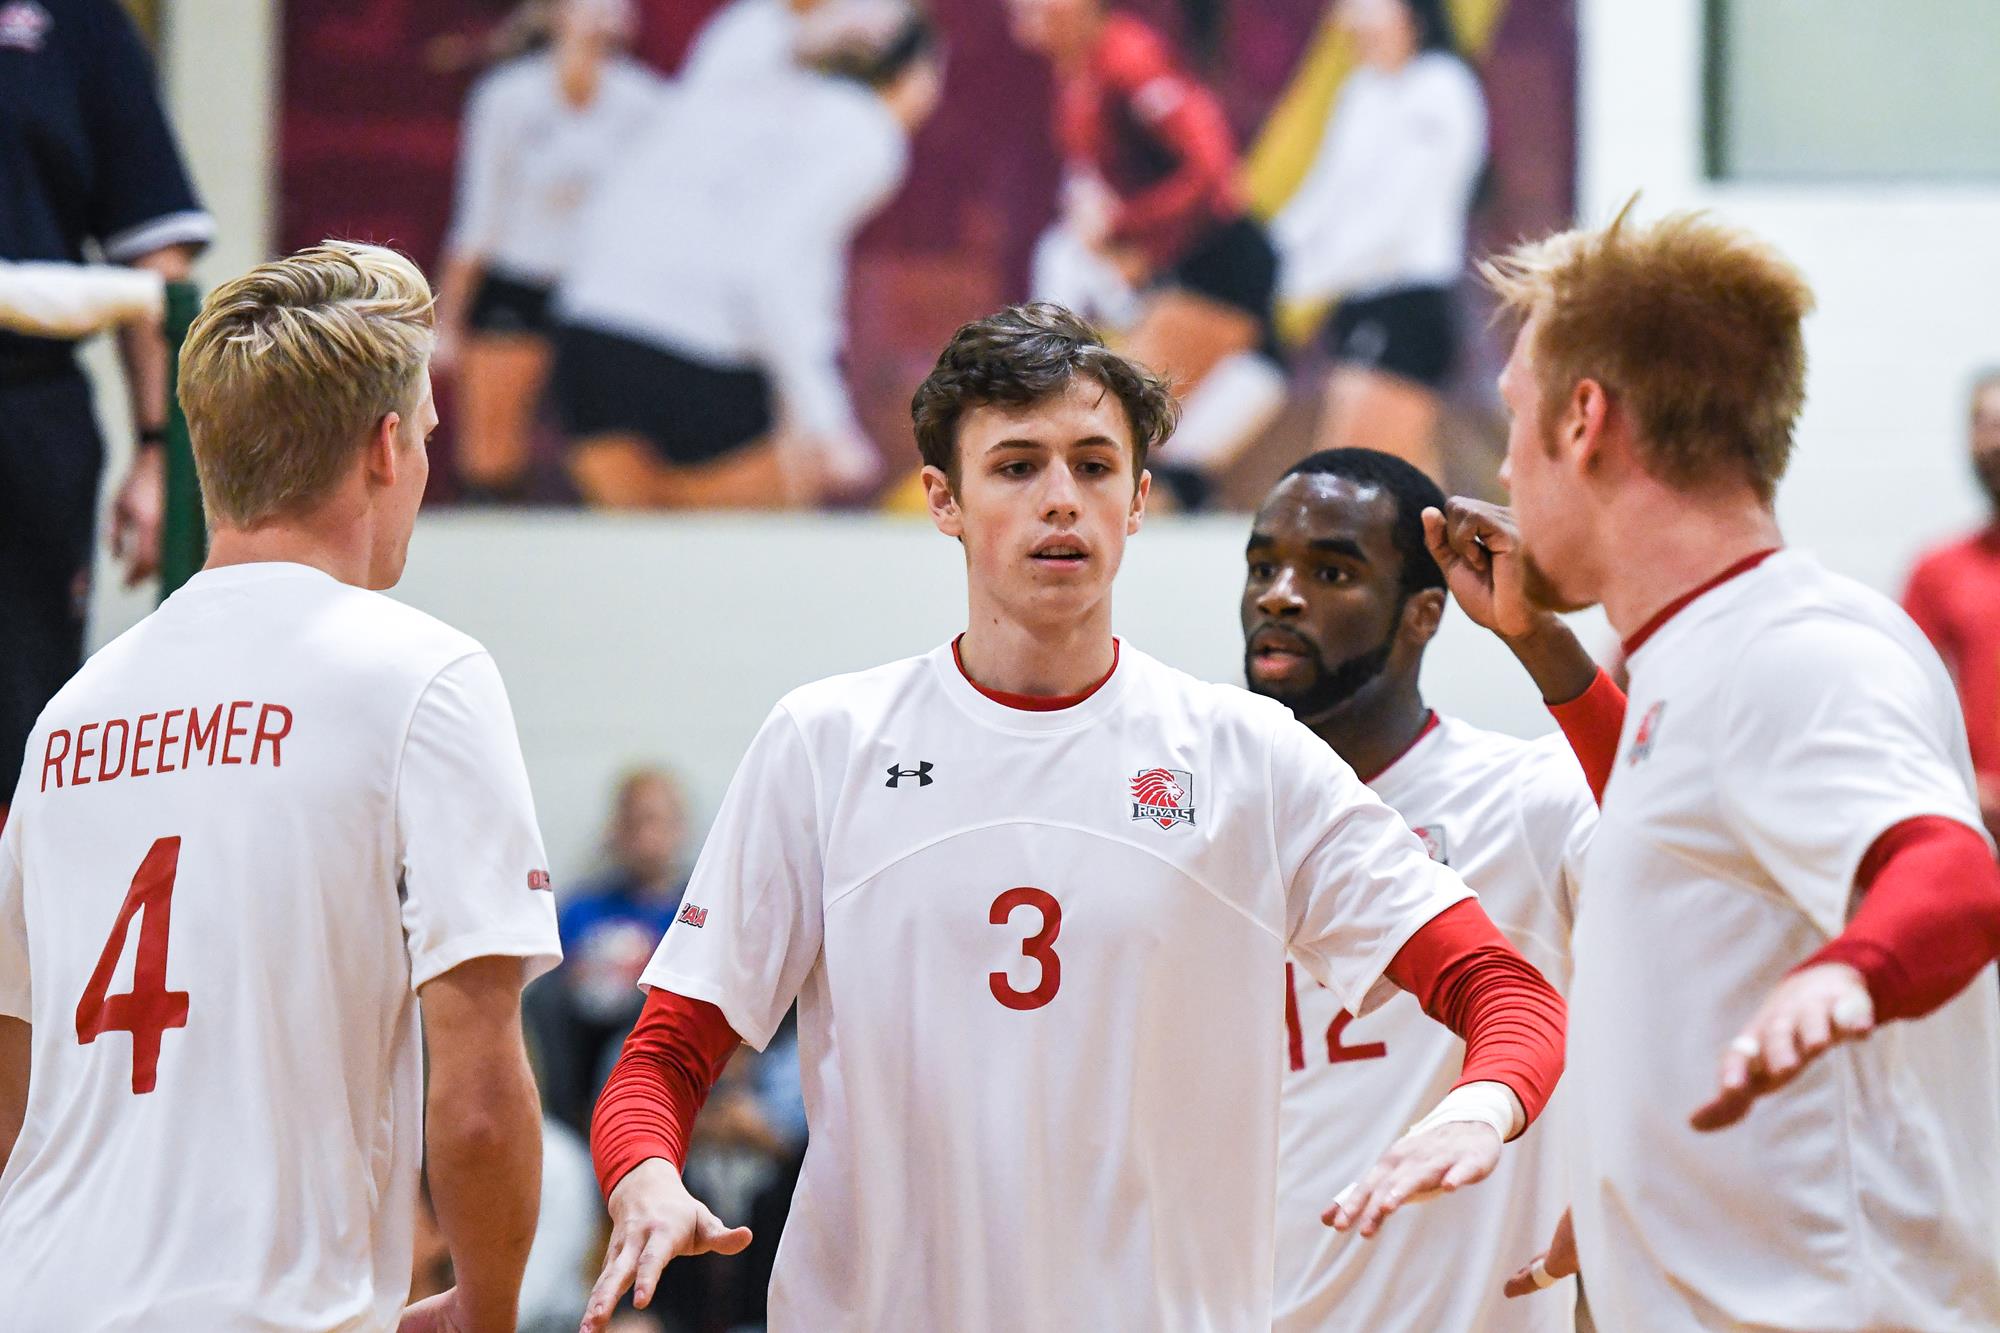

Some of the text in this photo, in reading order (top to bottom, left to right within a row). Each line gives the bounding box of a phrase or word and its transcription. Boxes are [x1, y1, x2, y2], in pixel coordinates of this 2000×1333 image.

[41, 701, 293, 792] REDEEMER
[1137, 804, 1191, 821] ROYALS
[75, 836, 190, 1094] 4
[989, 886, 1062, 1011] 3
